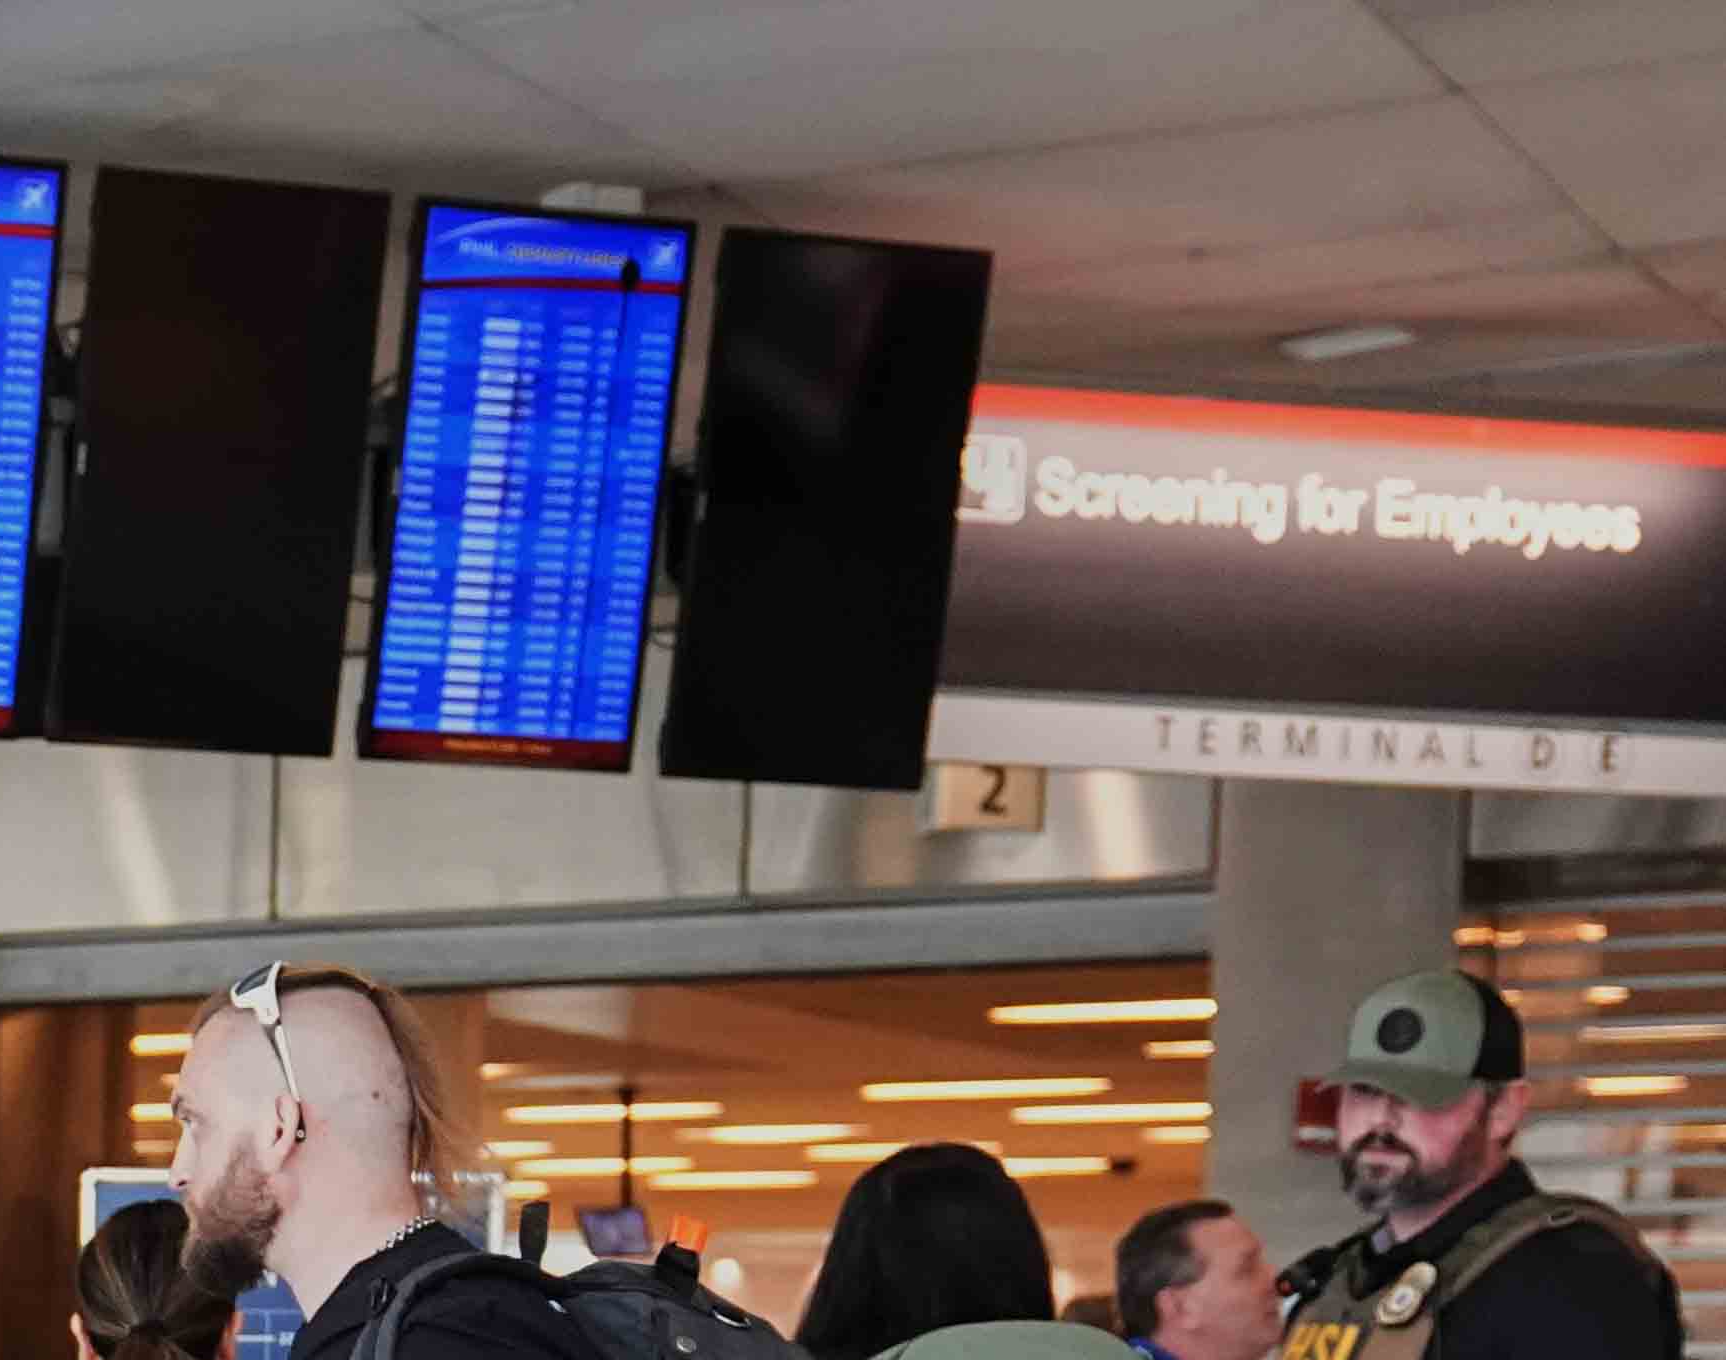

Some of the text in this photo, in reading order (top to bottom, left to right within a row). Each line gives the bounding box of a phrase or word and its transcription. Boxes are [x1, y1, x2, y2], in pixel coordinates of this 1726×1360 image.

[1034, 454, 1642, 560] Screening for Employees
[1155, 714, 1621, 773] TERMINAL D E
[980, 764, 1008, 816] 2
